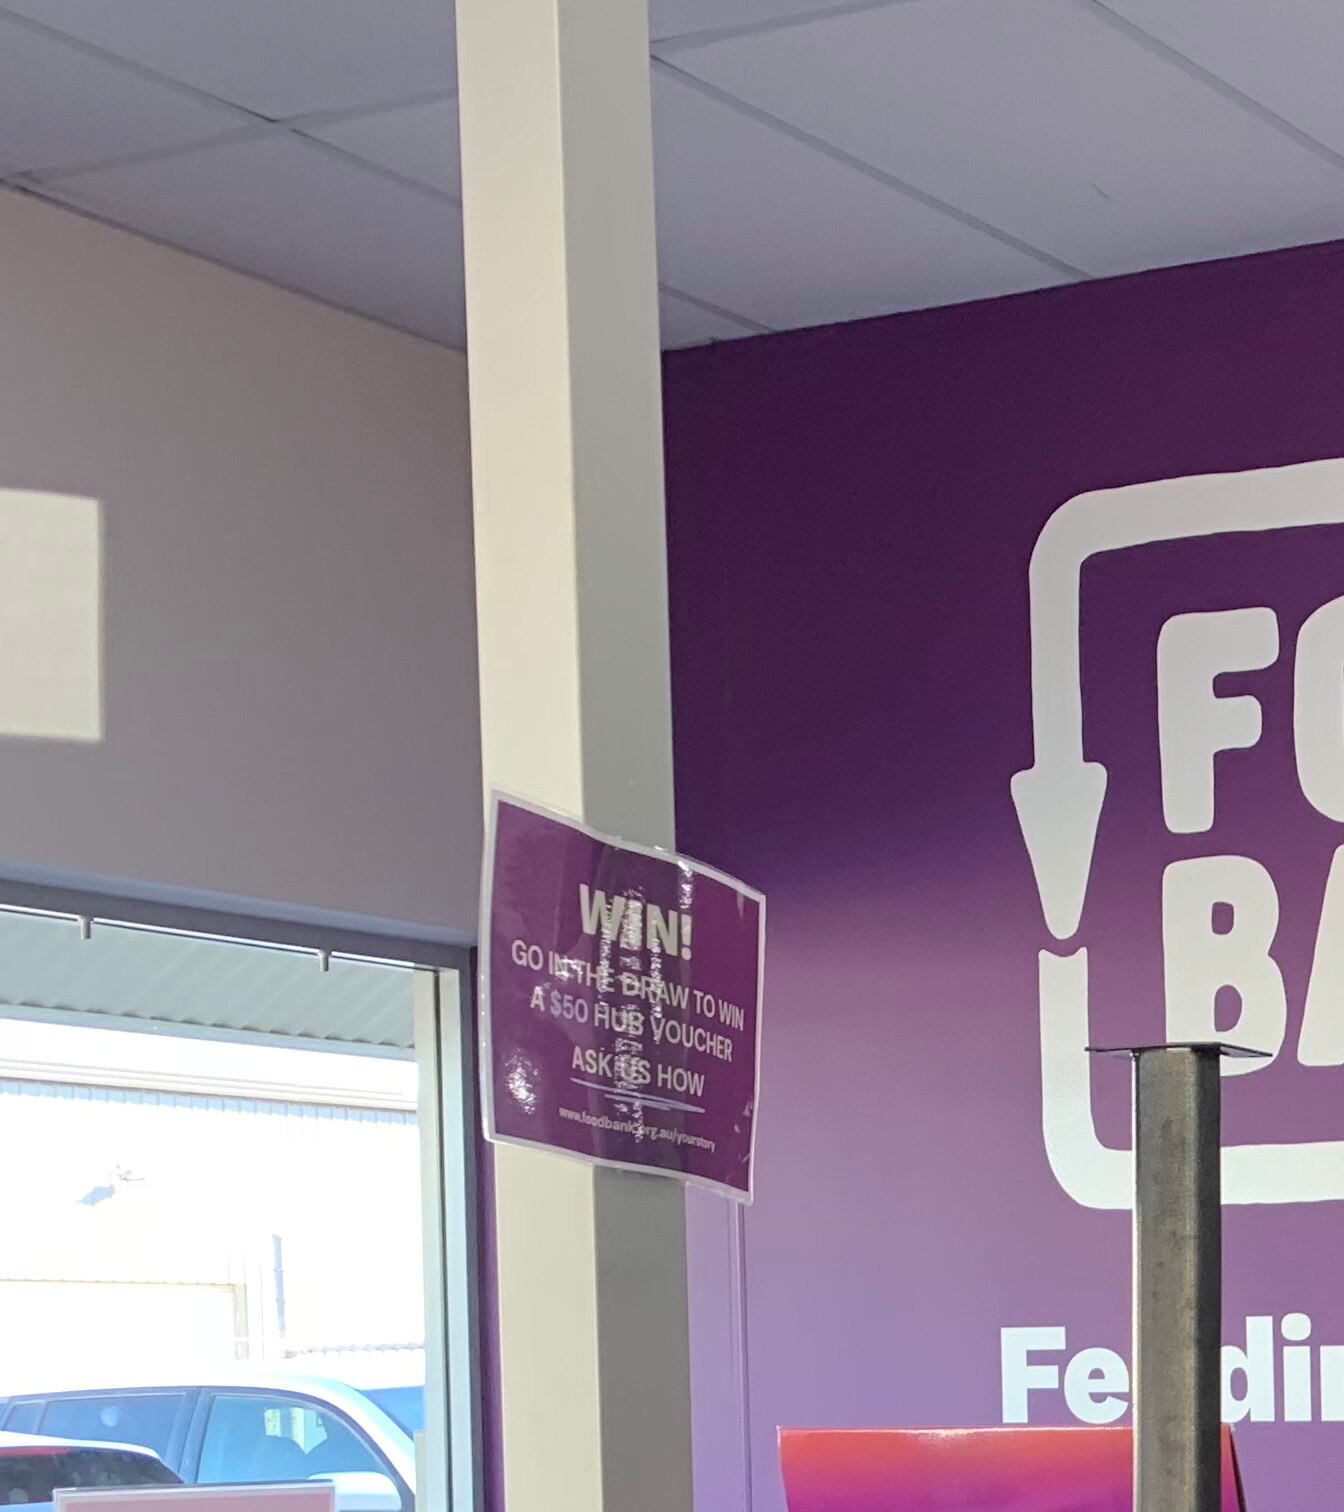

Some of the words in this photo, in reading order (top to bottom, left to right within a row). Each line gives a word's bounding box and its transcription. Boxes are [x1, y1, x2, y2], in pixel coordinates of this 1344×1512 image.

[579, 883, 692, 961] WIN!
[511, 939, 544, 971] GO
[574, 960, 615, 993] THE
[622, 971, 690, 1010] DRAW
[693, 989, 716, 1018] TO
[718, 998, 745, 1032] WIN
[530, 985, 545, 1012] A
[550, 988, 589, 1024] $50
[594, 1002, 644, 1036] HUB
[650, 1014, 733, 1063] VOUCHER
[572, 1046, 613, 1078] ASK
[657, 1063, 705, 1097] HOW
